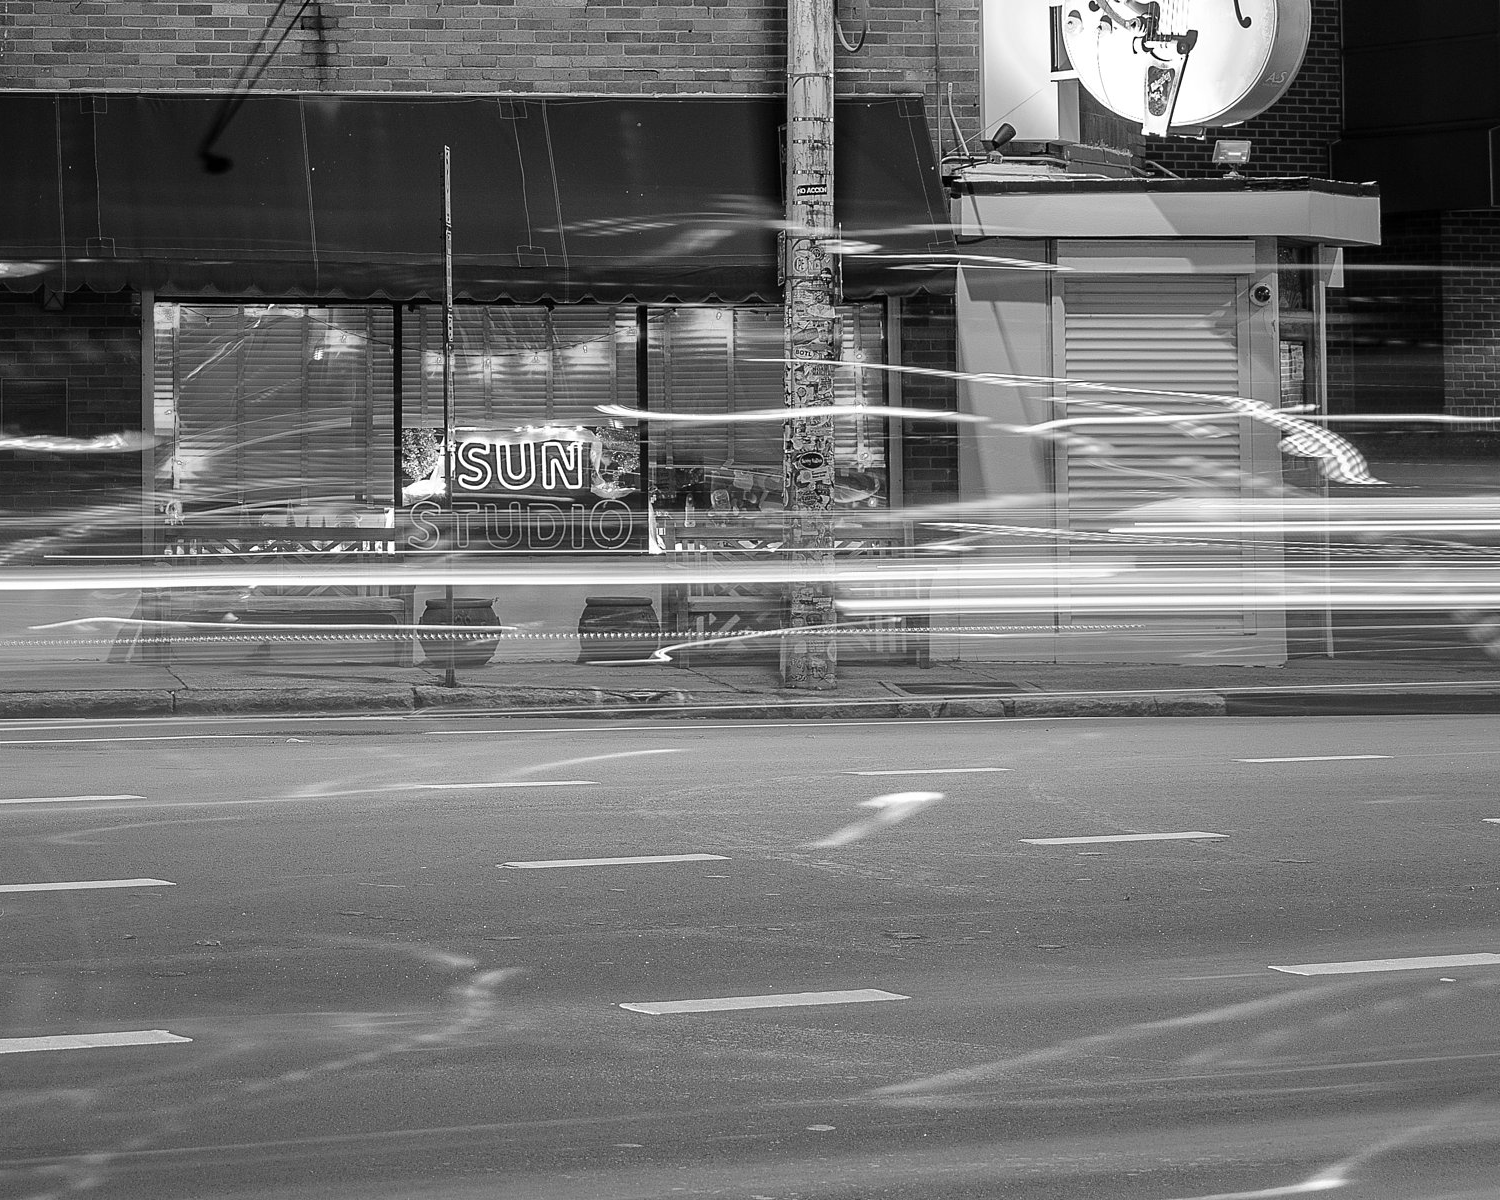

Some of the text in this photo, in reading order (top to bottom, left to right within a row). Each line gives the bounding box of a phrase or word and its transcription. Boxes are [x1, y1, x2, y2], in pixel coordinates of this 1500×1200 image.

[795, 349, 812, 357] BOTL
[457, 439, 583, 490] SUN
[407, 499, 633, 550] STUDIO
